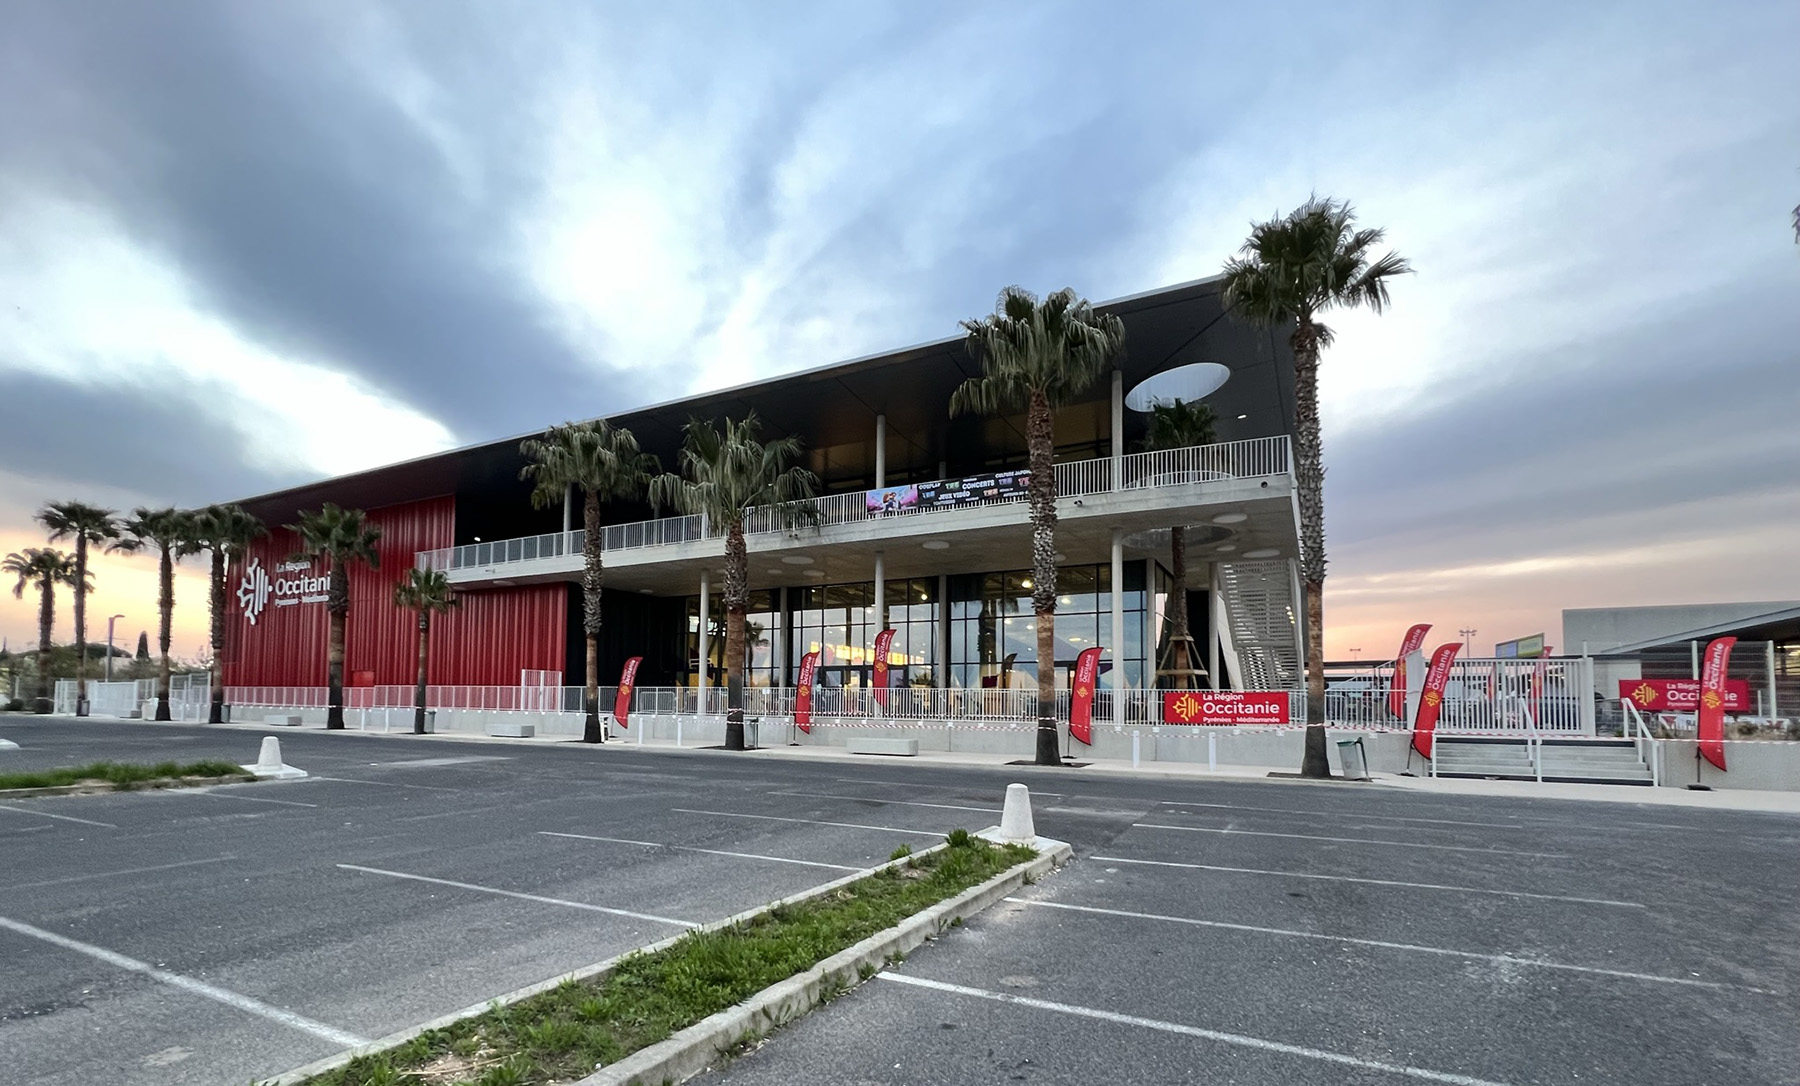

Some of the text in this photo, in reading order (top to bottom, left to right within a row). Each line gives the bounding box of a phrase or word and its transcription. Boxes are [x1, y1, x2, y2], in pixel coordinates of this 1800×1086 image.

[962, 479, 995, 490] CONCERTS
[276, 562, 285, 573] La
[275, 570, 331, 596] Occitani
[1431, 649, 1451, 690] Occitanie
[1708, 643, 1724, 690] Occitanie
[1203, 693, 1244, 703] La Région
[1666, 690, 1738, 702] Occiie
[1203, 701, 1280, 714] Occitanie
